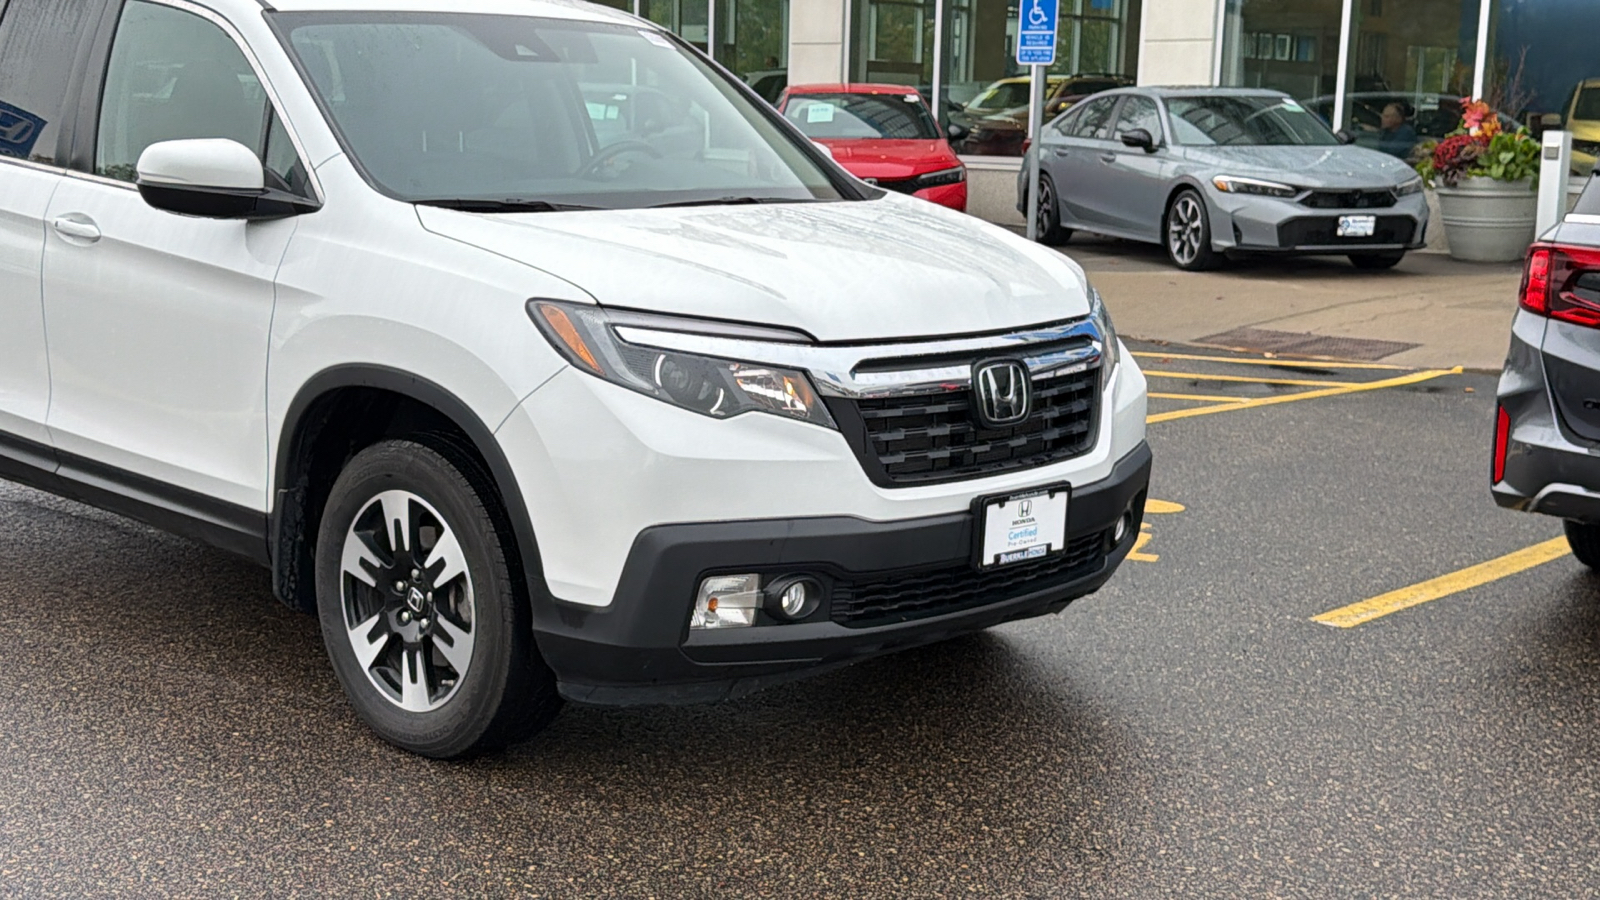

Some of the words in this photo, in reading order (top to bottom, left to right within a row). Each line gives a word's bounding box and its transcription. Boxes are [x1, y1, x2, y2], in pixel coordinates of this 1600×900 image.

[1012, 517, 1035, 526] HONDA
[1008, 526, 1037, 540] Certified
[1008, 538, 1037, 547] Pre-Owned
